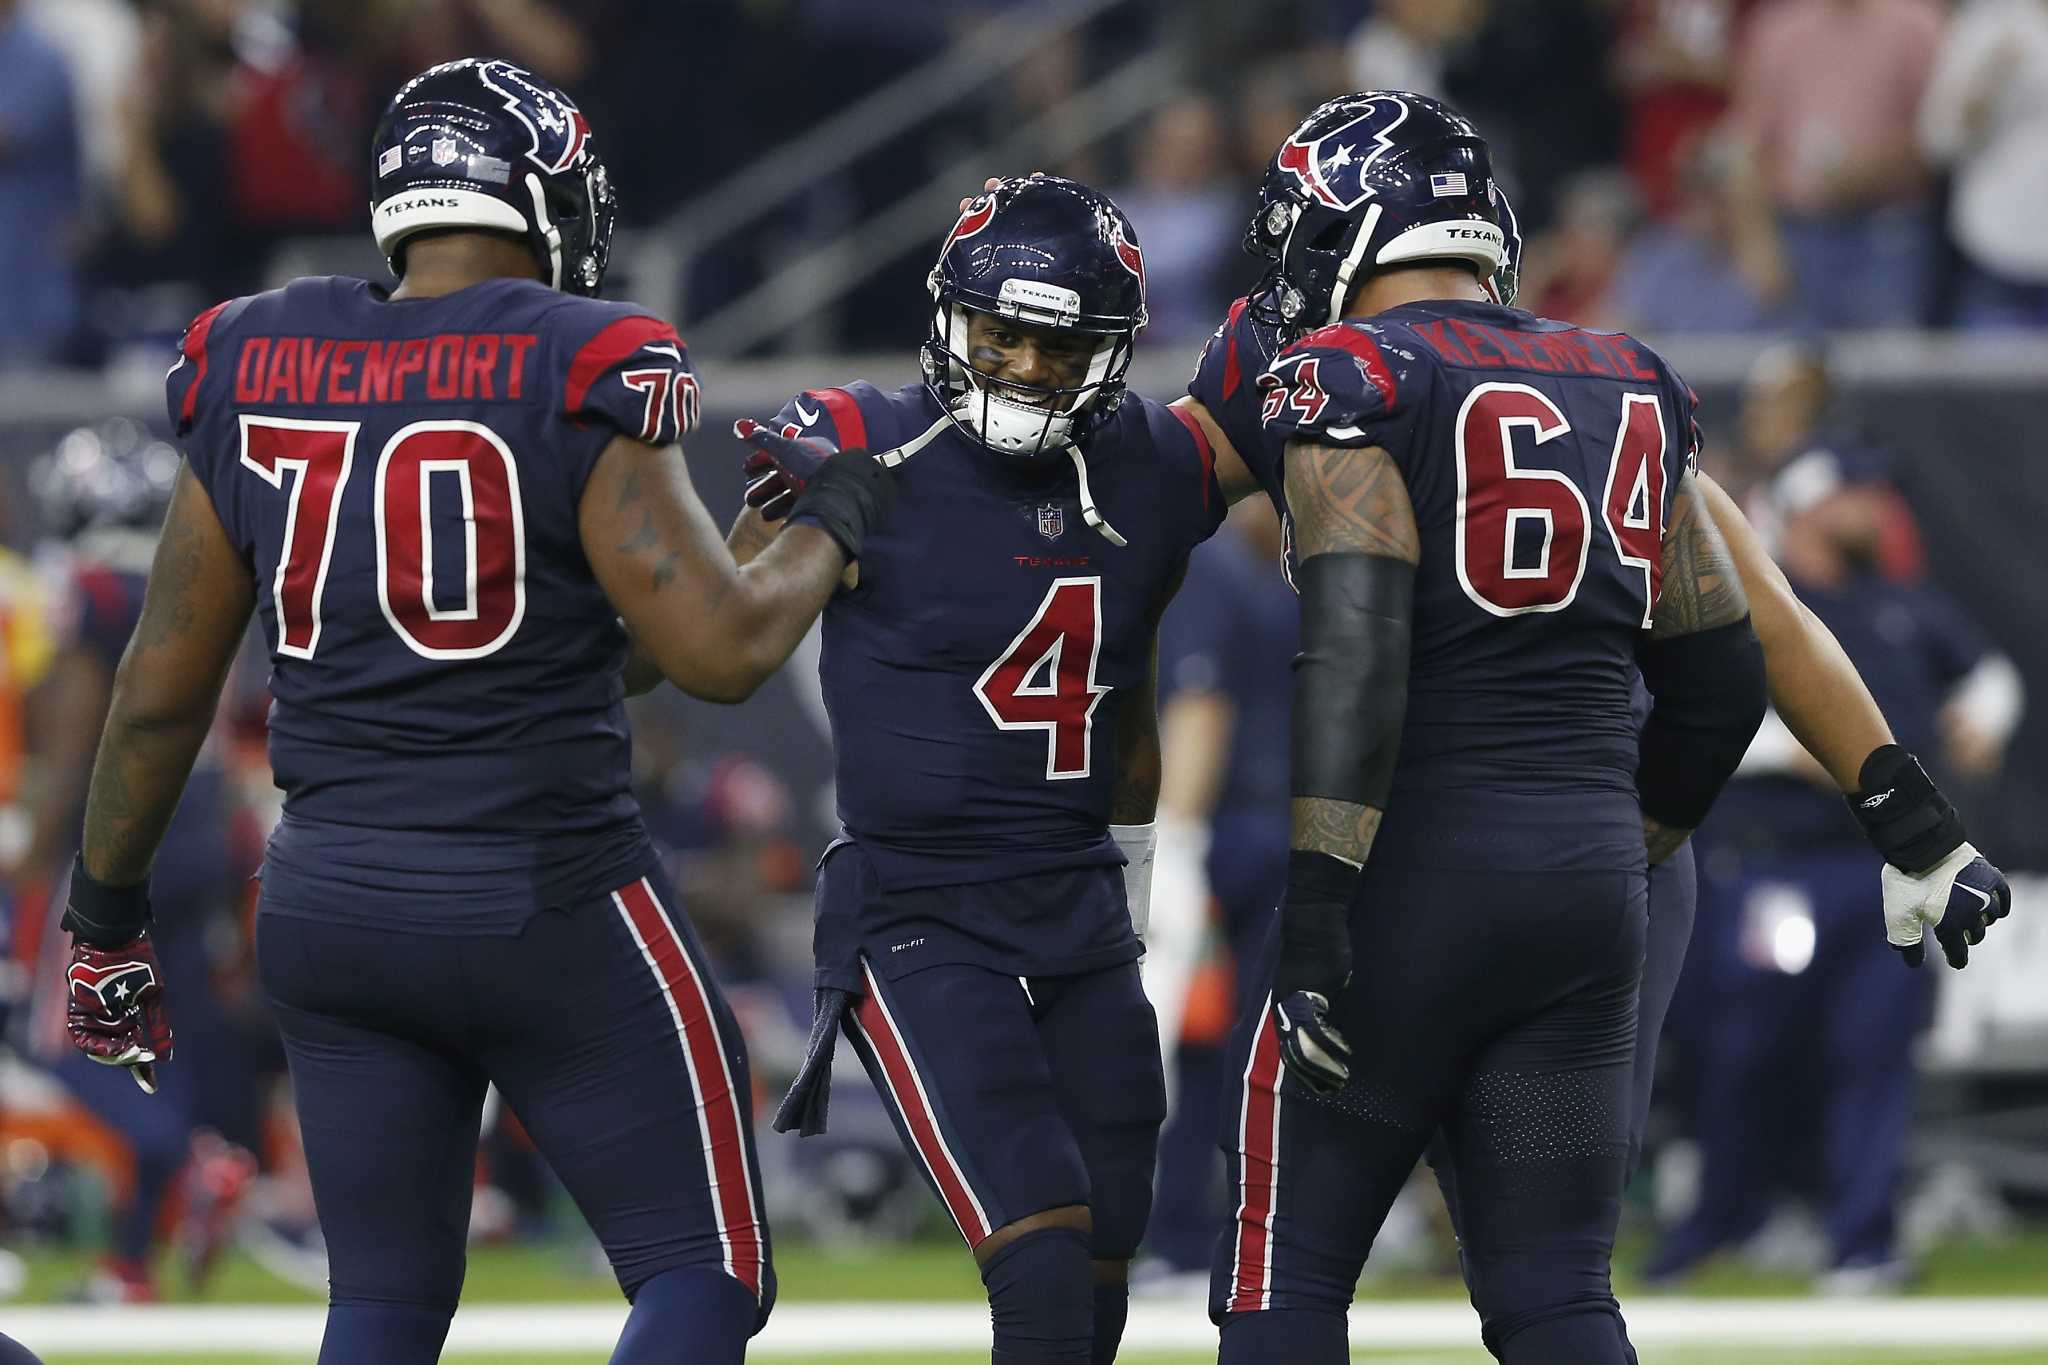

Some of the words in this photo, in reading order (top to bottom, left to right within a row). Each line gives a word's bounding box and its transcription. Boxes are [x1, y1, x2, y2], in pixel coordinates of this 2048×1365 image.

[385, 198, 459, 217] TEXANS
[1446, 228, 1502, 246] TEXANS
[1022, 289, 1061, 301] TEXANS
[236, 333, 537, 405] DAVENPORT
[1255, 358, 1330, 430] 64
[621, 368, 700, 443] 70
[238, 414, 526, 661] 70
[1454, 381, 1668, 630] 64
[972, 575, 1113, 781] 4
[891, 938, 925, 953] DRI-FIT
